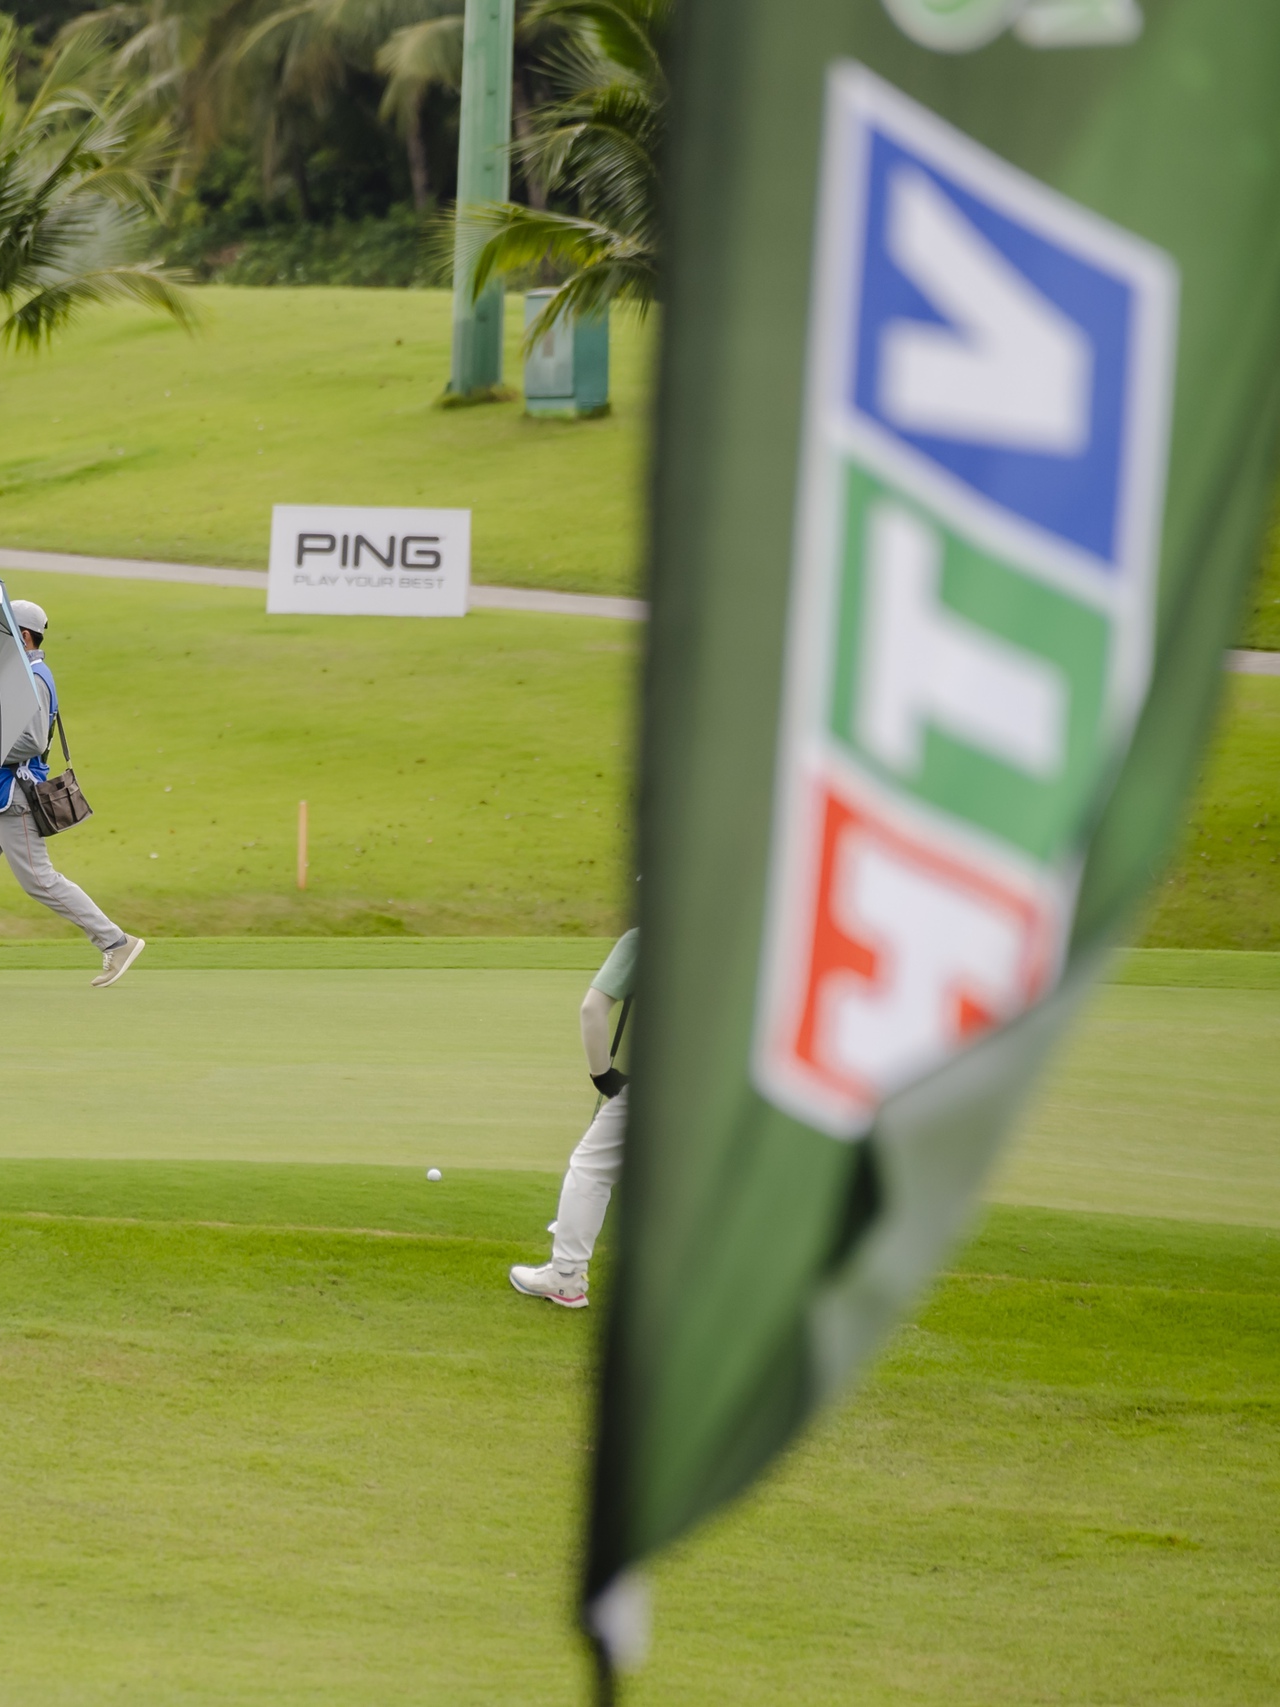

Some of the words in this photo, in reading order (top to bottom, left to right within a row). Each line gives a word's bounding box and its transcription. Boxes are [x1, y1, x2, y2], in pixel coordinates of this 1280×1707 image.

[295, 532, 442, 570] PING
[293, 575, 340, 587] PLAY
[345, 576, 395, 588] YOUR
[399, 577, 445, 589] BEST
